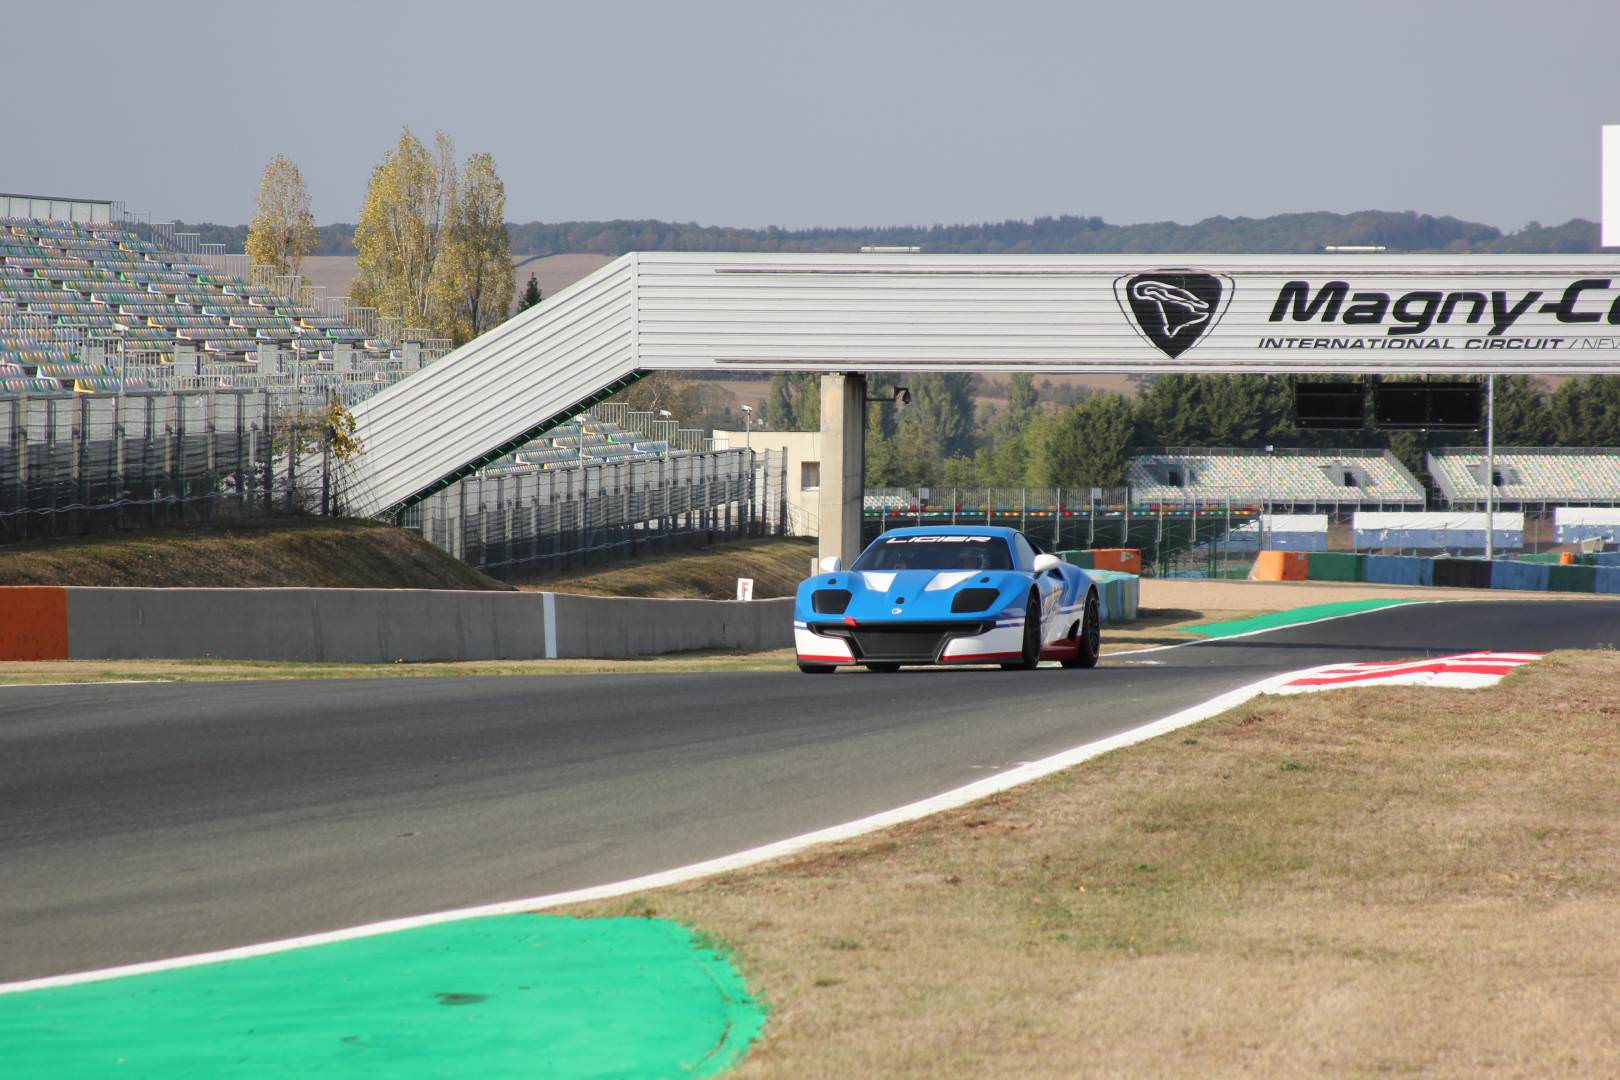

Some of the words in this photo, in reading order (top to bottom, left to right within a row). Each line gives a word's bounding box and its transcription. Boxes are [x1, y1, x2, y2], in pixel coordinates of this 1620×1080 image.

[1258, 338, 1455, 350] INTERNATIONAL
[1465, 338, 1564, 350] CIRCUIT
[885, 535, 992, 544] LIGIER
[741, 581, 750, 600] F
